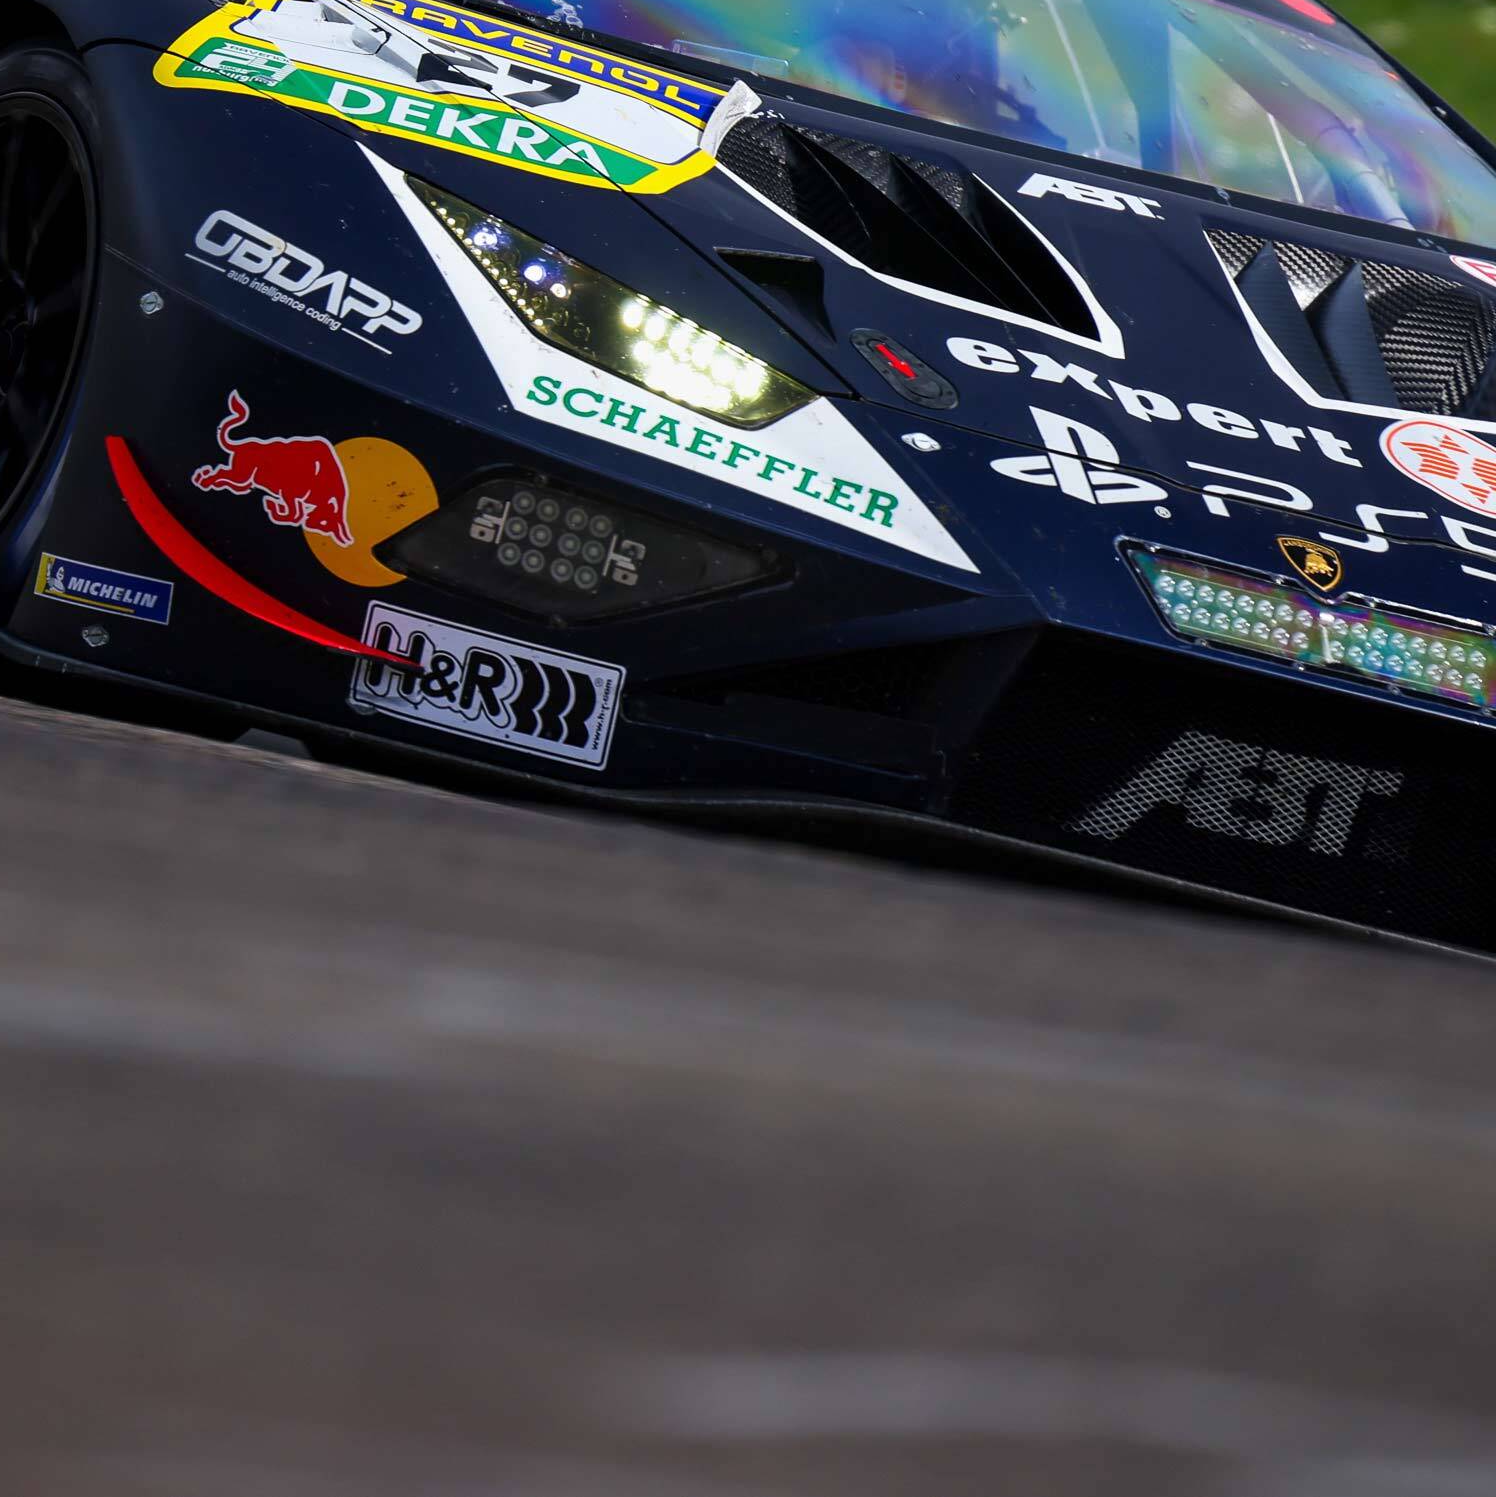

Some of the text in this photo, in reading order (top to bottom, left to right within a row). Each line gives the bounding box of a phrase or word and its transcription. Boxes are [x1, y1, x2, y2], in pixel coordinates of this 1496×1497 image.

[326, 82, 611, 180] DEKRA
[1016, 172, 1162, 220] ABT
[226, 266, 342, 332] auto intelligence coding
[946, 336, 1364, 468] expert
[525, 375, 900, 530] SCHAEFFLER
[66, 575, 158, 610] MICHELIN
[367, 620, 508, 721] H&R
[590, 678, 614, 752] www.h-r.com
[1064, 729, 1404, 857] ABT
